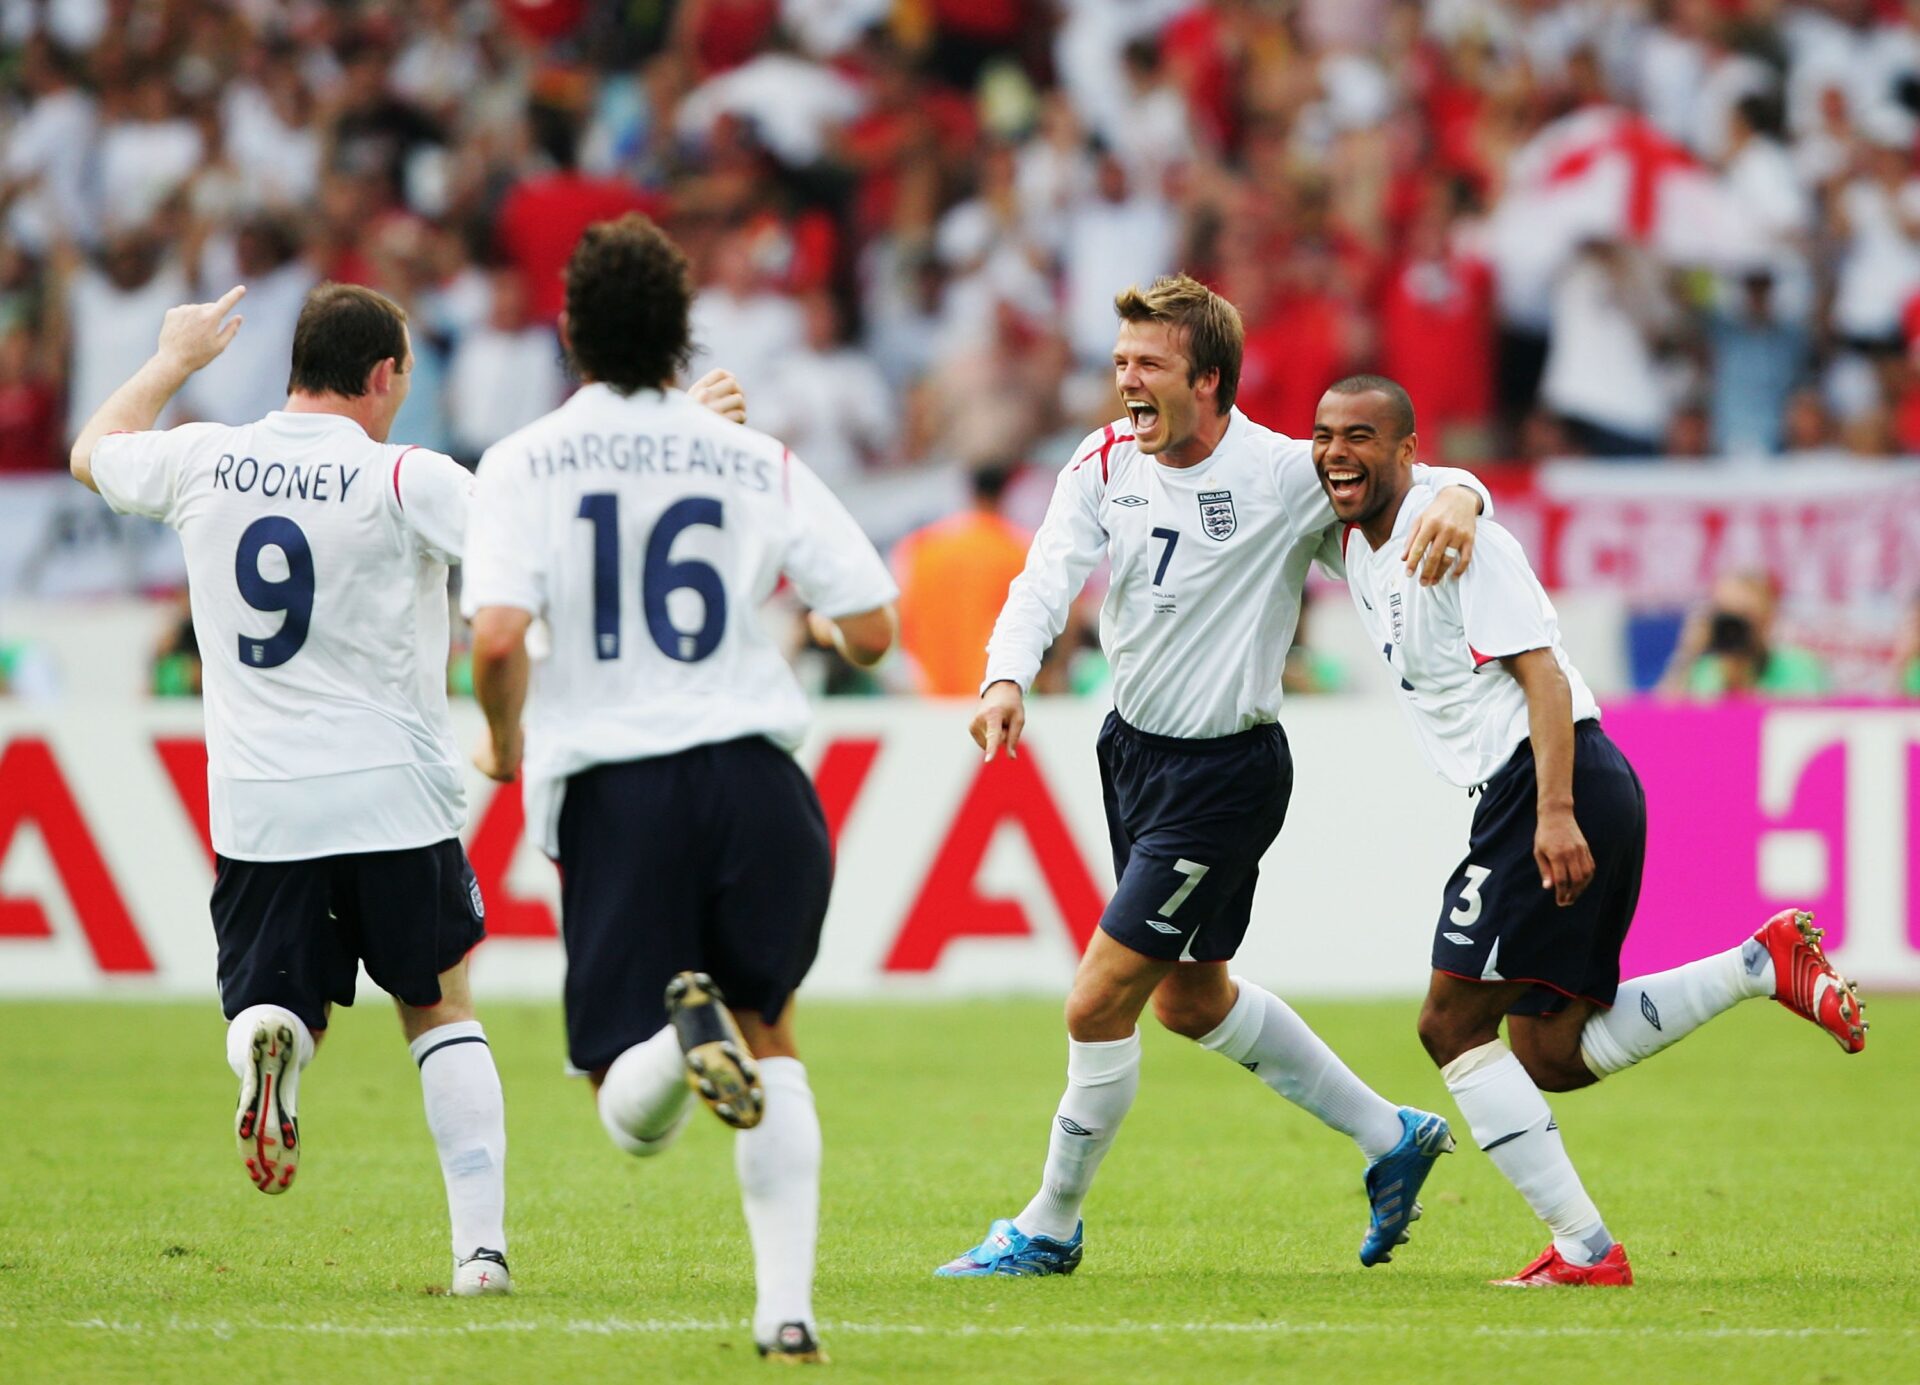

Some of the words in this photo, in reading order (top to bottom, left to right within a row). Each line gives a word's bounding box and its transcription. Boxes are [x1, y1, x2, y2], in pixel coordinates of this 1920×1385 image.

[213, 454, 361, 503] ROONEY
[529, 432, 771, 494] HARGREAVES
[1199, 492, 1230, 501] ENGLAND
[577, 492, 728, 663] 16
[1151, 527, 1180, 586] 7
[235, 515, 315, 669] 9
[1173, 858, 1210, 918] 7
[1449, 864, 1492, 926] 3
